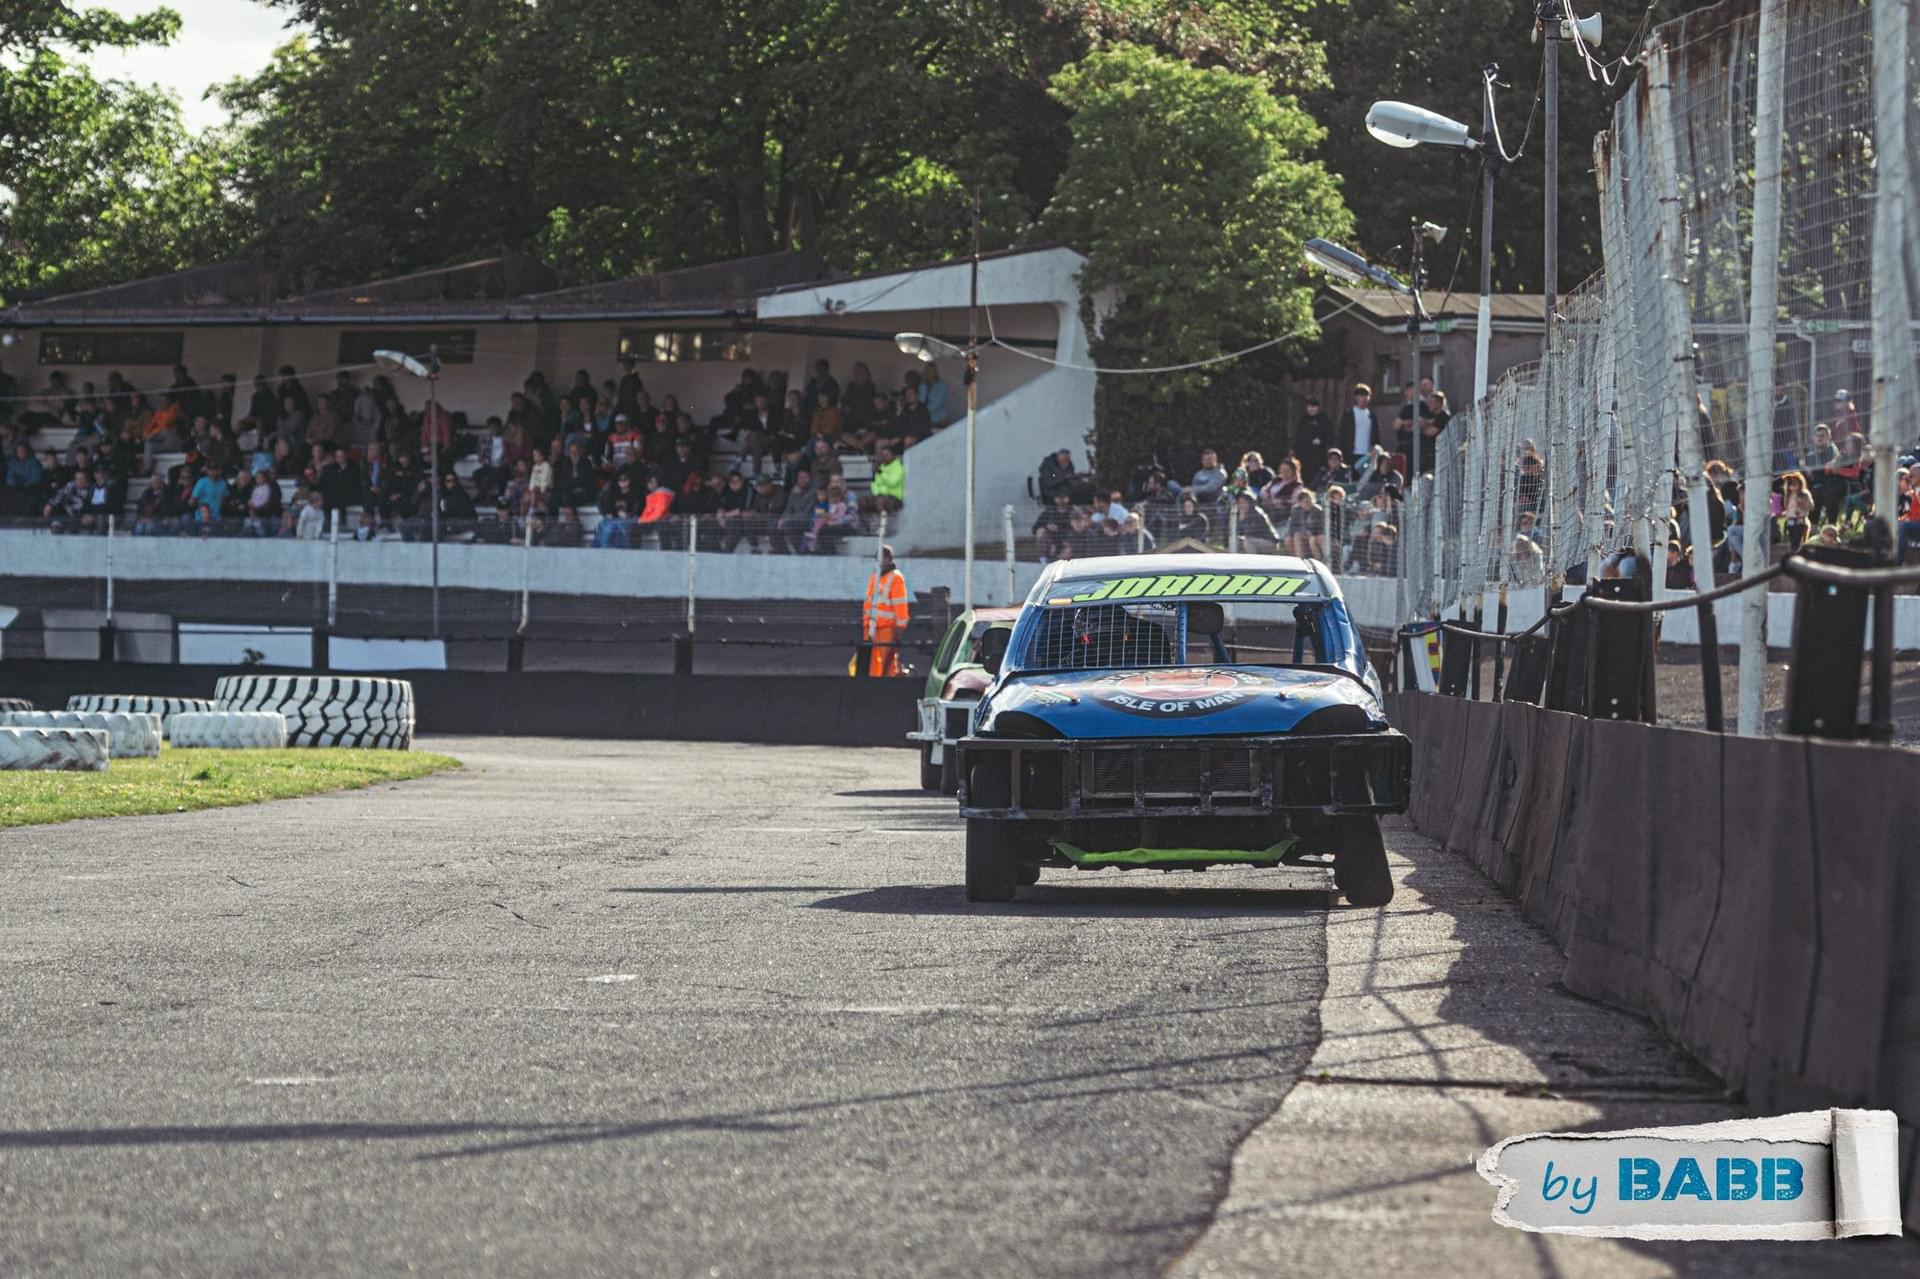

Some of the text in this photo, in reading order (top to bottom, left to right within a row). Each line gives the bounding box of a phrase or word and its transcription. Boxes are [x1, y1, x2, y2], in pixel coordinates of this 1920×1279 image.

[1073, 574, 1306, 601] JORDAN
[1109, 691, 1245, 713] ISLE OF MAN
